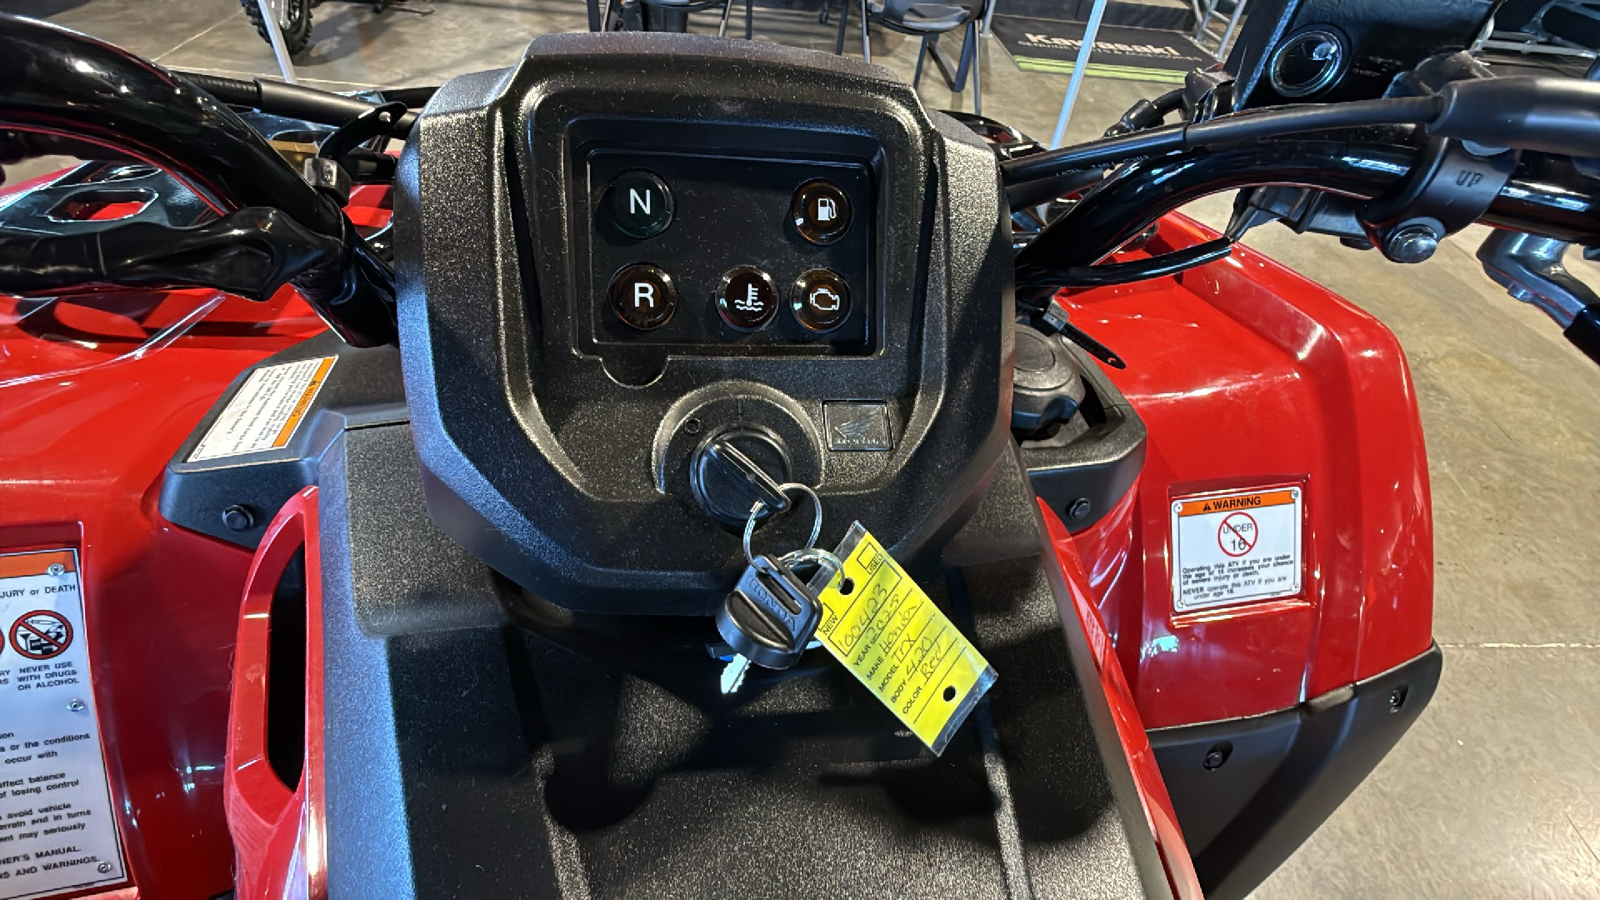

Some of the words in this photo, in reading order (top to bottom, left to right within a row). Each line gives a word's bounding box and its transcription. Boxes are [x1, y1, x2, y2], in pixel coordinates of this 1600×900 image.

[1456, 169, 1484, 187] UP
[630, 188, 650, 214] N
[634, 283, 654, 308] R
[1212, 496, 1261, 510] WARNING
[1222, 522, 1253, 534] UNDER
[1231, 538, 1246, 552] 16
[866, 553, 883, 575] USED
[1182, 566, 1210, 574] Operating
[0, 588, 25, 598] JURY
[44, 584, 76, 594] DEATH
[1183, 586, 1204, 595] NEVER
[823, 614, 838, 635] NEW
[853, 645, 871, 667] YEAR
[18, 674, 40, 682] WITH
[45, 670, 77, 678] DRUGS
[20, 664, 50, 674] NEVER
[867, 657, 884, 680] MAKE
[36, 678, 80, 688] ALCOHOL
[879, 665, 900, 691] MODEL
[892, 681, 907, 704] BODY
[903, 686, 923, 714] COLOR
[44, 733, 90, 746] conditions
[5, 755, 32, 764] occur
[38, 750, 58, 758] with
[28, 772, 66, 784] balance
[12, 786, 42, 796] losing
[46, 780, 79, 790] control
[7, 808, 34, 818] avoid
[38, 803, 72, 813] vehicle
[32, 816, 48, 825] and
[67, 810, 92, 818] turns
[19, 832, 38, 840] may
[44, 822, 86, 835] seriously
[16, 866, 38, 876] AND
